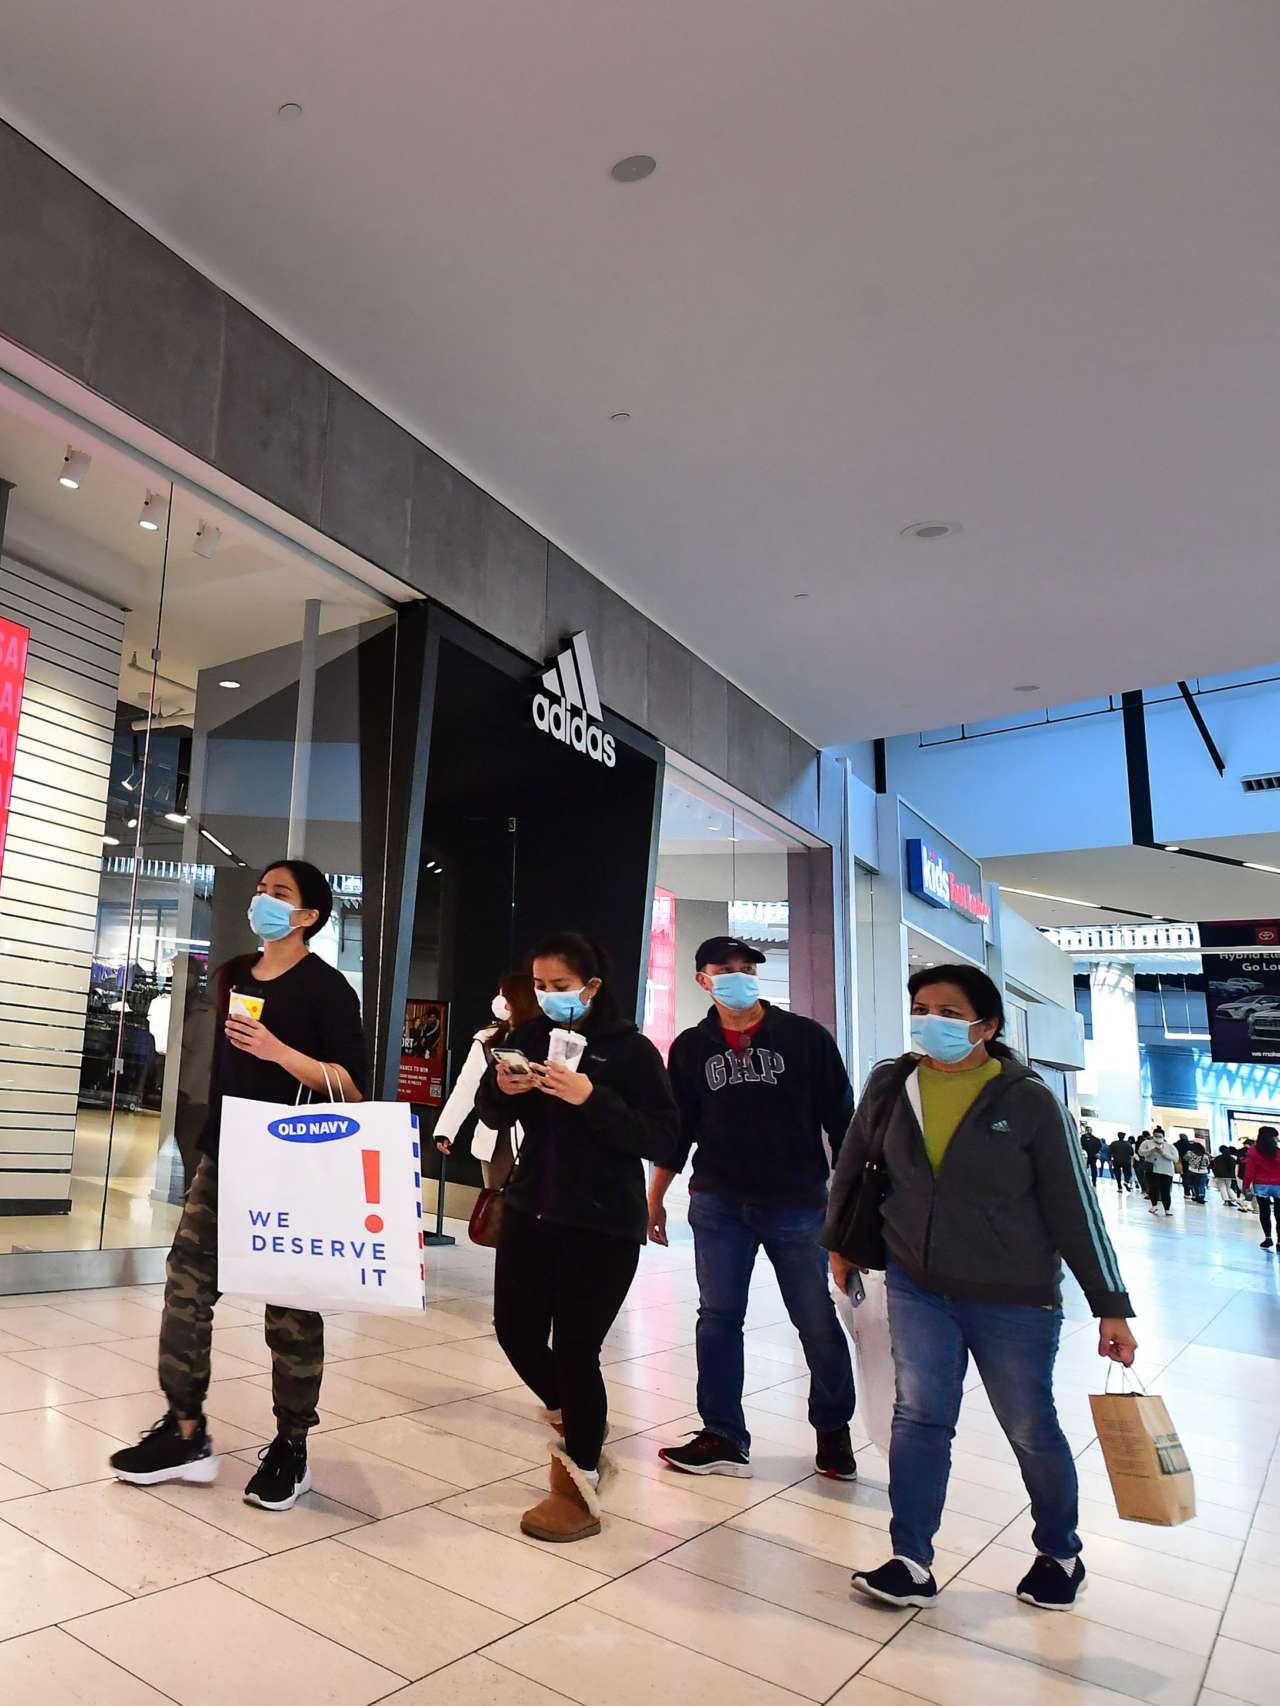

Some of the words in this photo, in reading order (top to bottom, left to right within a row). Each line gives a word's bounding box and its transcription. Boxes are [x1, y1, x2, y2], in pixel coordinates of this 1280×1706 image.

[532, 693, 616, 768] adidas
[1242, 962, 1260, 971] Go
[705, 1048, 785, 1091] GAP
[278, 1123, 306, 1135] OLD
[309, 1121, 348, 1135] NAVY
[248, 1209, 289, 1228] WE
[252, 1235, 386, 1260] DESERVE
[361, 1268, 386, 1286] IT
